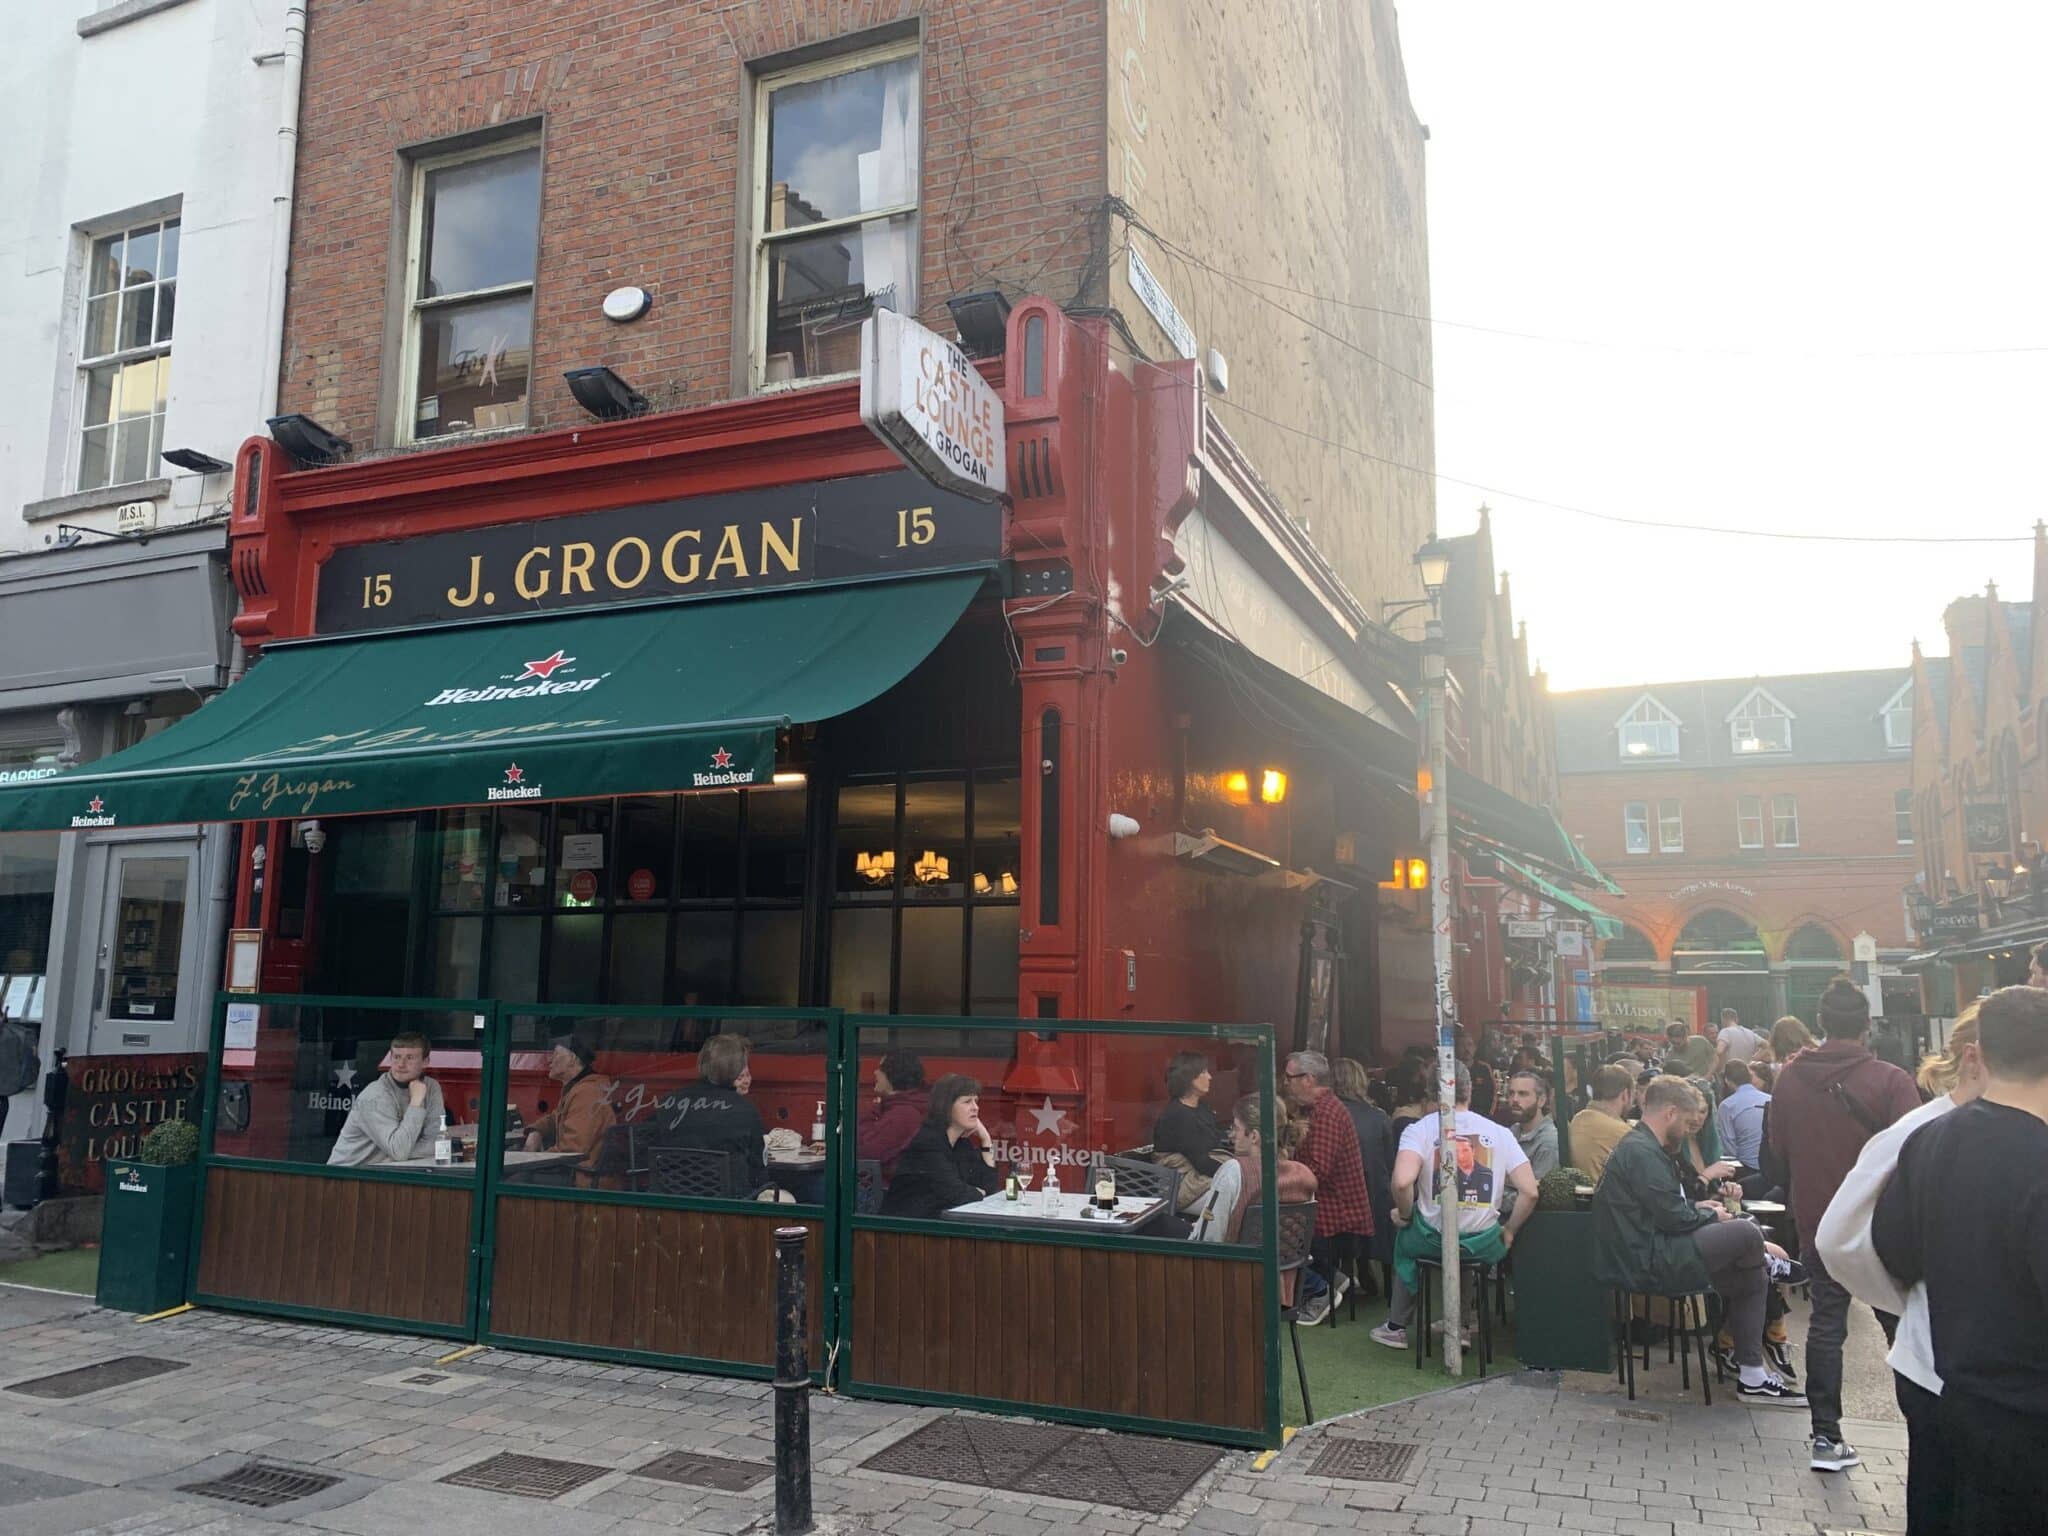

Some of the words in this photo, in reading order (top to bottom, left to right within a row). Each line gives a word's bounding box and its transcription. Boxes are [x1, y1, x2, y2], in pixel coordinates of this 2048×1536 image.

[946, 344, 967, 379] THE
[921, 347, 990, 432] CASTLE
[916, 377, 993, 469] LOUNGE
[936, 430, 986, 485] GROGAN
[896, 506, 935, 547] 15
[362, 573, 392, 608] 15
[447, 555, 495, 608] J.
[514, 517, 802, 601] GROGAN
[424, 677, 602, 706] Heineken
[693, 770, 753, 787] Heineken
[488, 786, 541, 800] Heineken
[71, 815, 115, 828] Heineken
[90, 1099, 186, 1127] CASTLE
[308, 1092, 357, 1111] Heine
[88, 1135, 144, 1161] LOU
[992, 1139, 1106, 1167] Heineken
